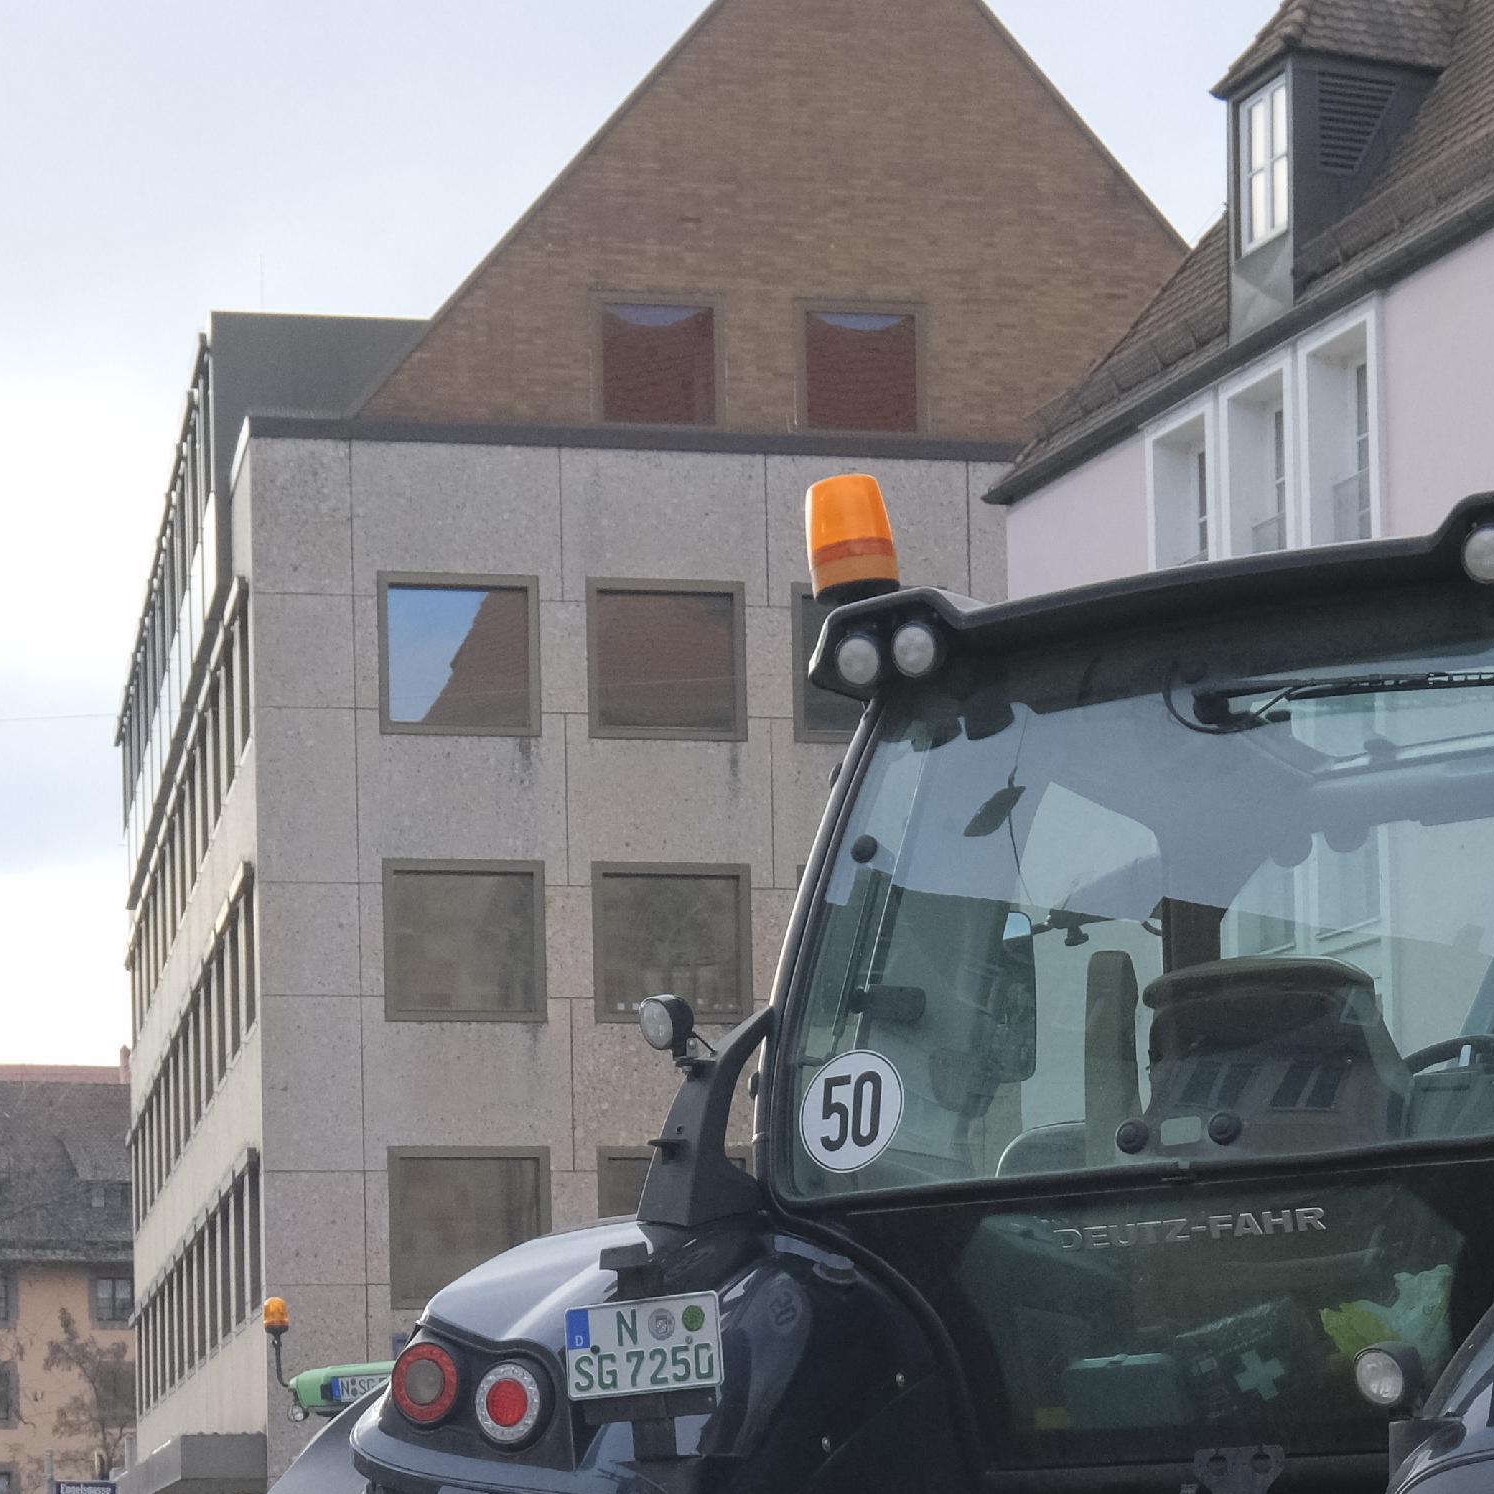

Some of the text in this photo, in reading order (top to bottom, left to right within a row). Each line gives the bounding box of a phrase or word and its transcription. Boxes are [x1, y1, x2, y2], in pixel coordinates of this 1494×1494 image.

[821, 1071, 883, 1152] 50
[1053, 1206, 1327, 1249] DEUTZ-FAHR
[574, 1335, 584, 1347] D
[617, 1308, 638, 1347] N
[574, 1342, 714, 1392] SG 7250
